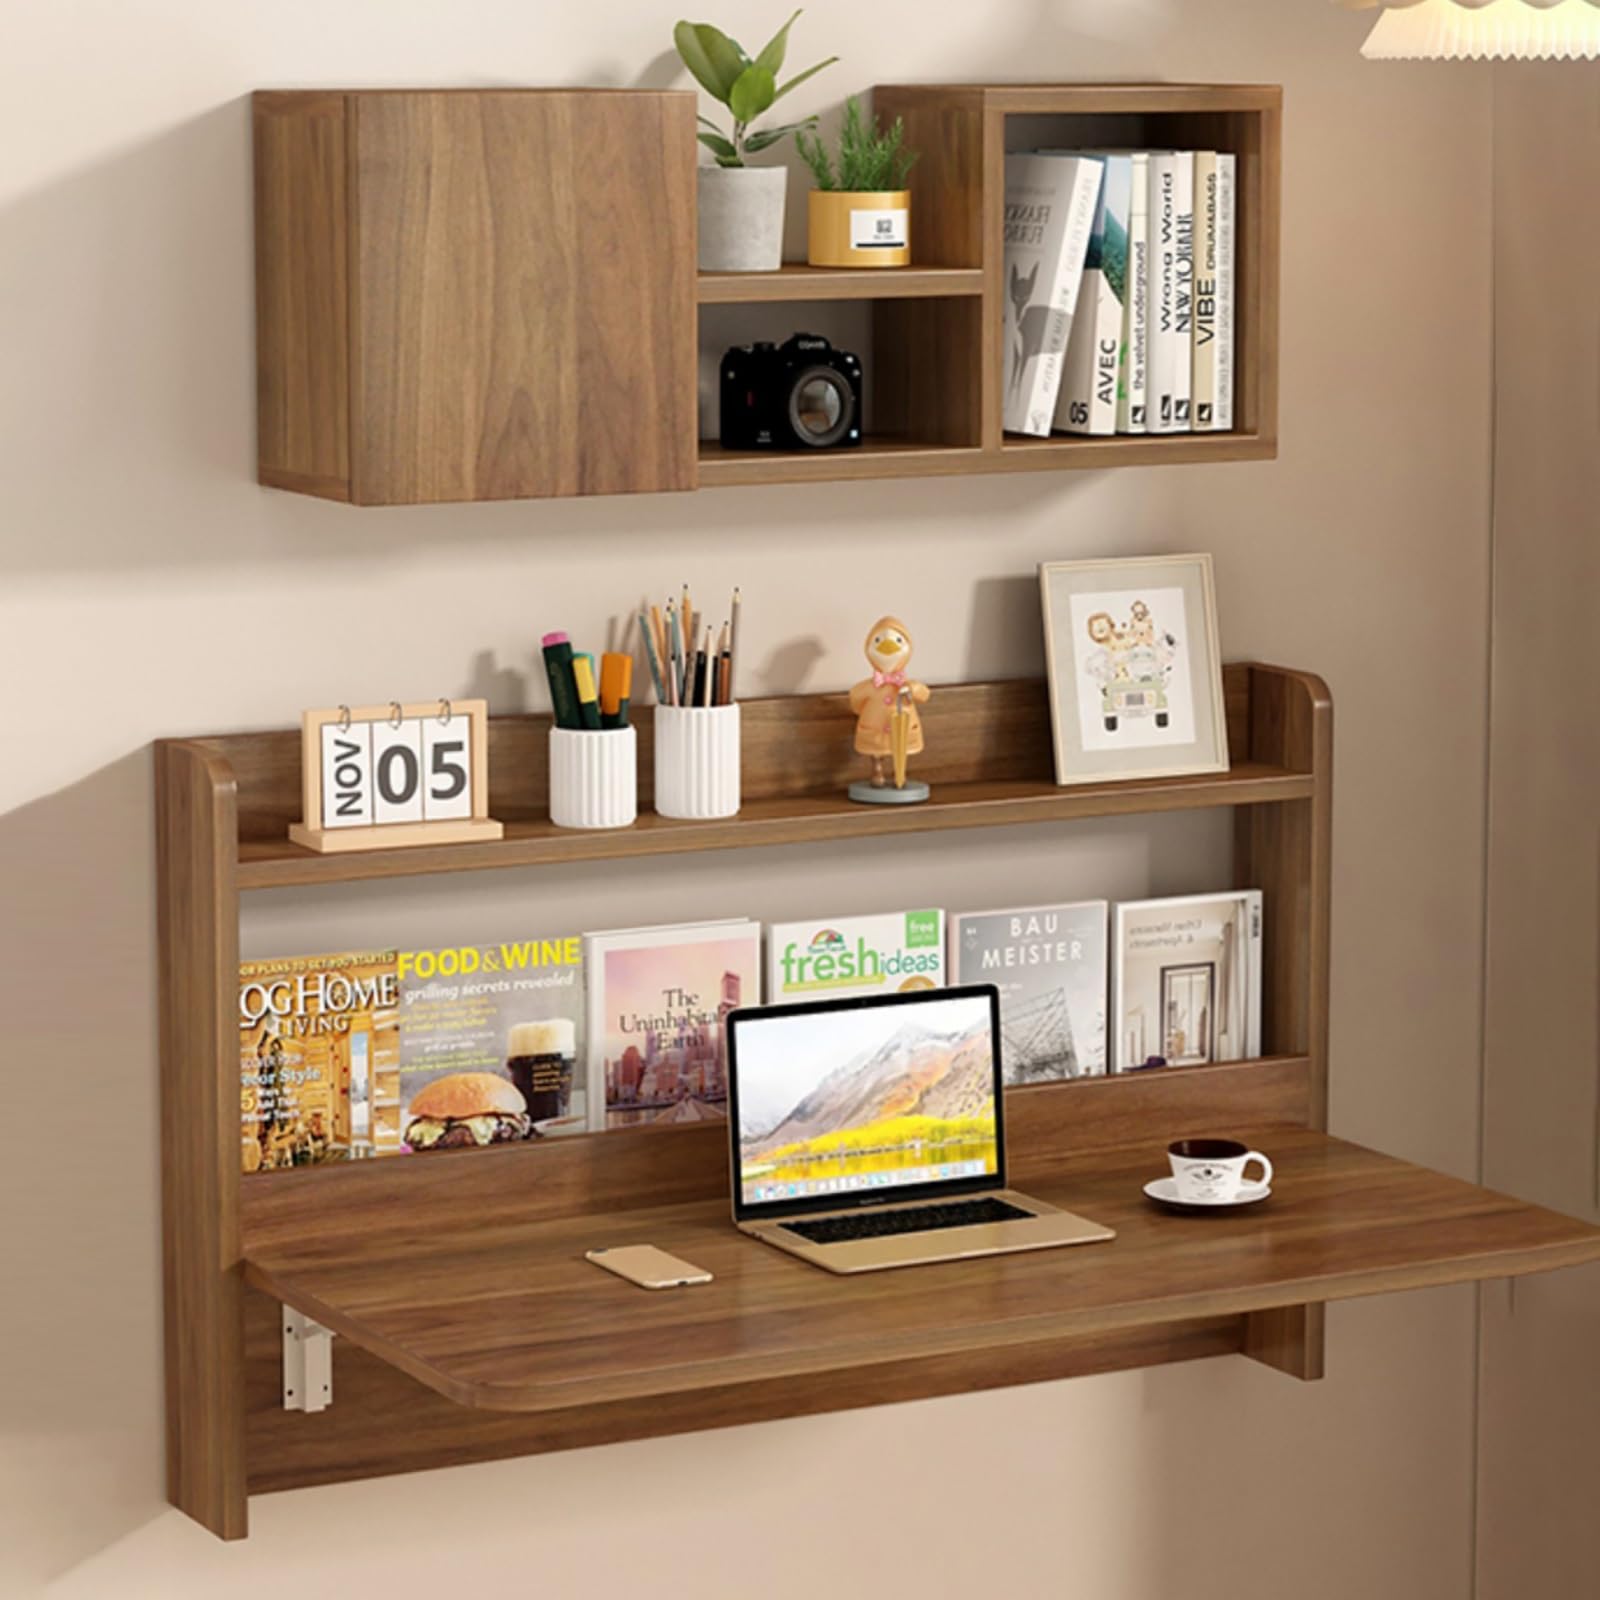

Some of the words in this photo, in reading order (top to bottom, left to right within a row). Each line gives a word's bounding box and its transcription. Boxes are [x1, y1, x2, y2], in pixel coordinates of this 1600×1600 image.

[1162, 172, 1172, 244] World
[1134, 241, 1147, 325] underground
[1161, 253, 1173, 332] Wrong
[1176, 290, 1191, 333] NEW
[1197, 279, 1215, 346] VIBE
[1133, 328, 1144, 364] velvet
[1097, 339, 1116, 405] AVEC
[1133, 369, 1144, 390] the
[334, 739, 363, 816] NOV
[1010, 914, 1058, 937] BAU
[780, 937, 879, 983] fresh
[880, 950, 939, 976] ideas
[982, 941, 1083, 969] MEISTER
[240, 983, 292, 1029] OG
[296, 972, 399, 1016] HOME
[405, 982, 460, 1005] grilling
[462, 979, 511, 996] secrets
[513, 969, 575, 991] revealed
[663, 988, 699, 1009] The
[656, 1028, 705, 1050] Earth
